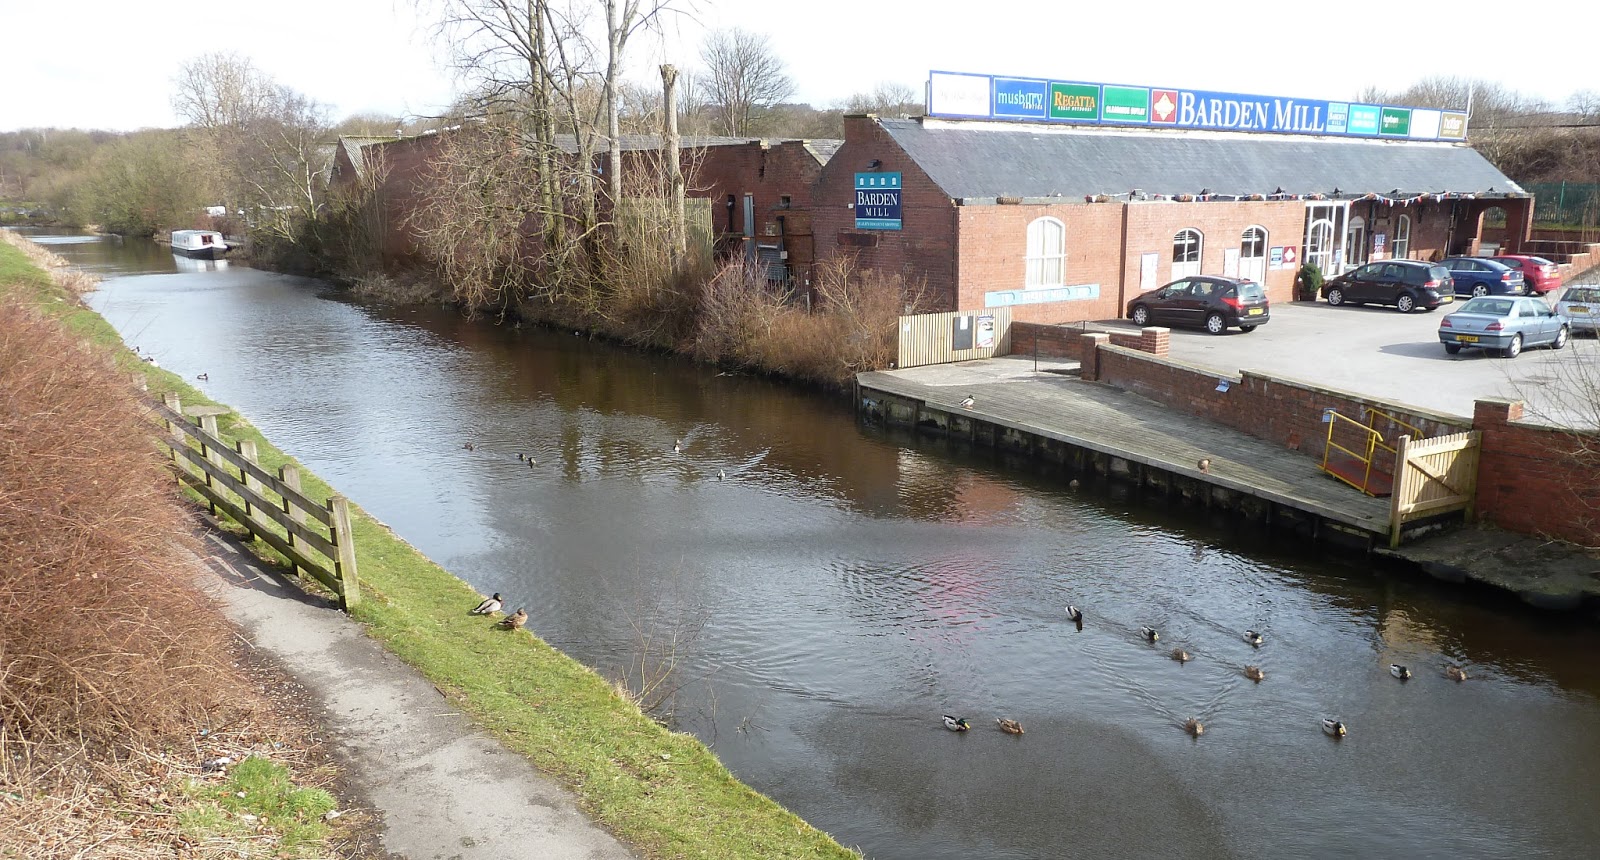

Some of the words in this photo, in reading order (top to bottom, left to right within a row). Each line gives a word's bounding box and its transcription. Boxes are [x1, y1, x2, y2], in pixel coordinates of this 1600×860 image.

[998, 90, 1043, 105] musbury
[1054, 91, 1096, 108] REGATTA
[1178, 91, 1270, 130] BARDEN
[1271, 99, 1325, 132] MILL
[857, 191, 898, 206] BARDEN
[865, 207, 890, 217] MILL
